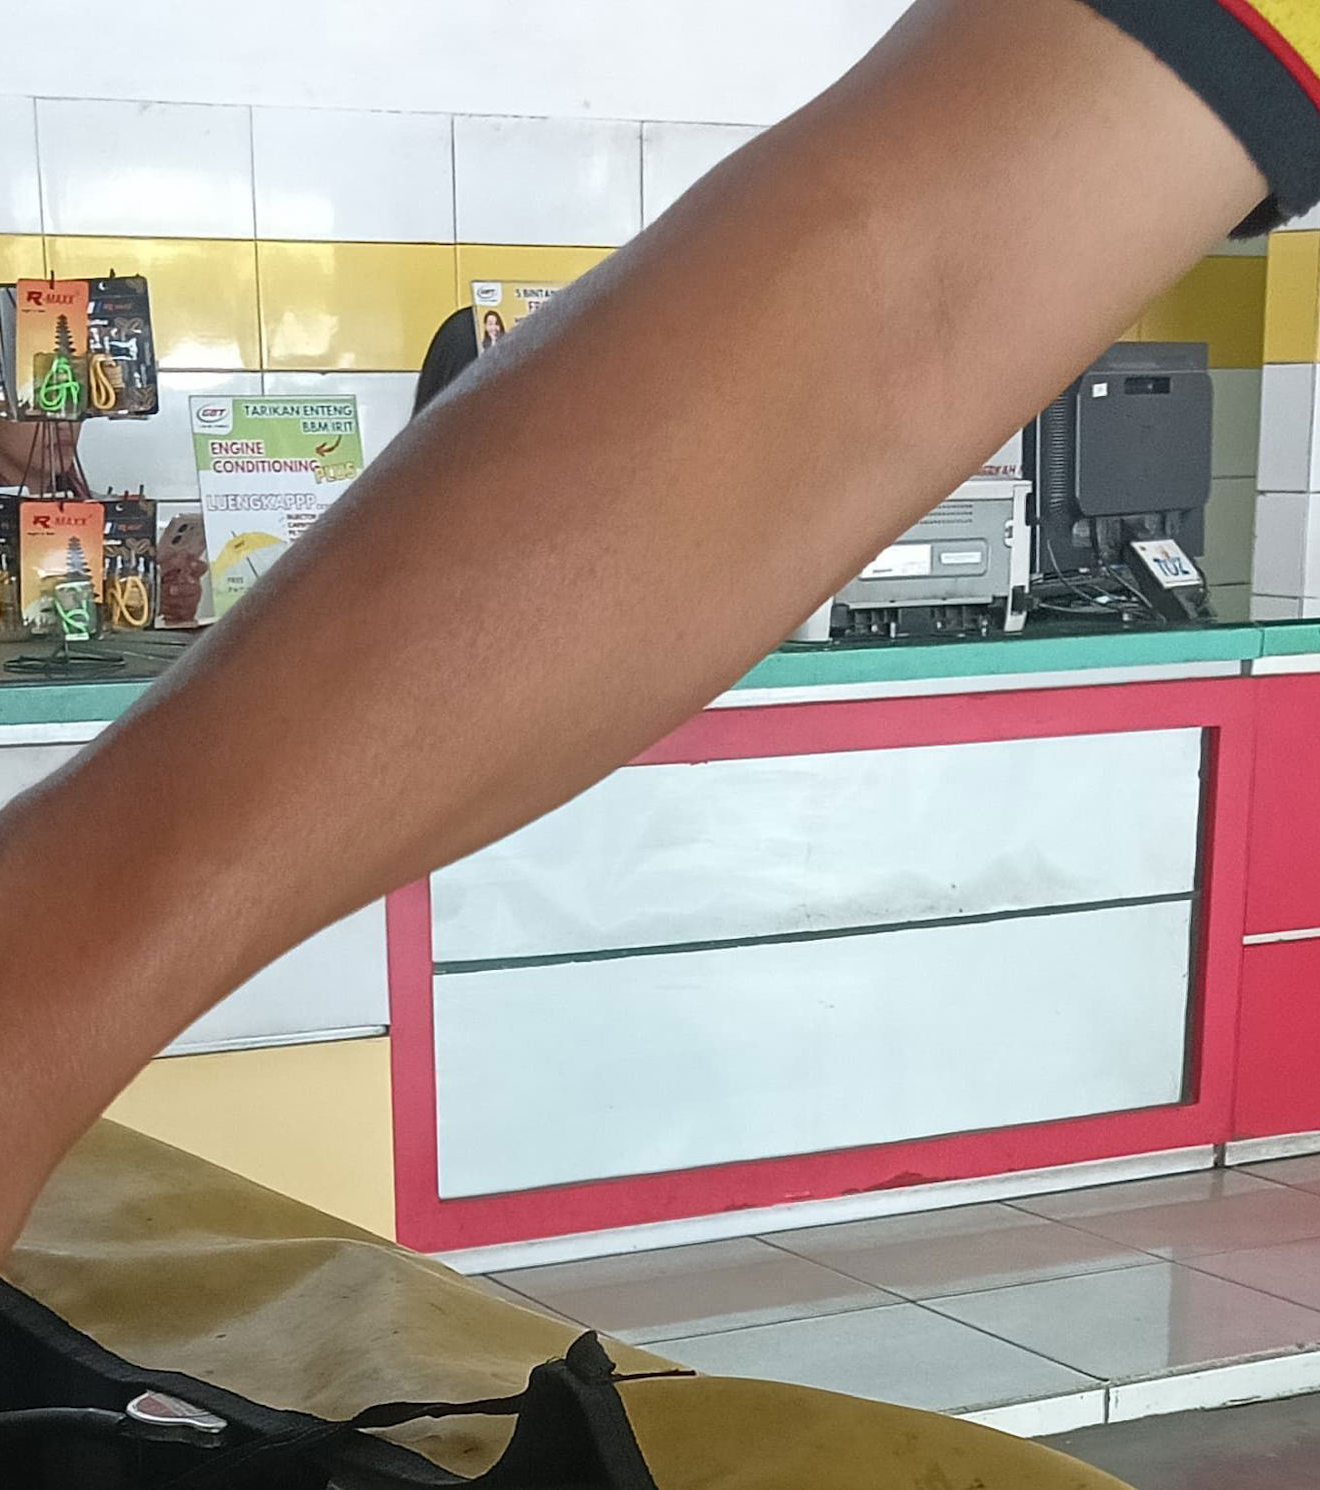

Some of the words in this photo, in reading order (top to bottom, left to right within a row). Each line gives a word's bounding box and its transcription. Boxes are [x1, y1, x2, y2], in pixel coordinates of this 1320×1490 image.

[244, 405, 300, 417] TARIKAN
[303, 405, 352, 417] ENTENG
[302, 421, 328, 433] BBM
[331, 421, 354, 433] IRIT
[210, 442, 264, 455] ENGINE
[212, 460, 318, 473] CONDITIONING
[315, 461, 356, 484] PLUS
